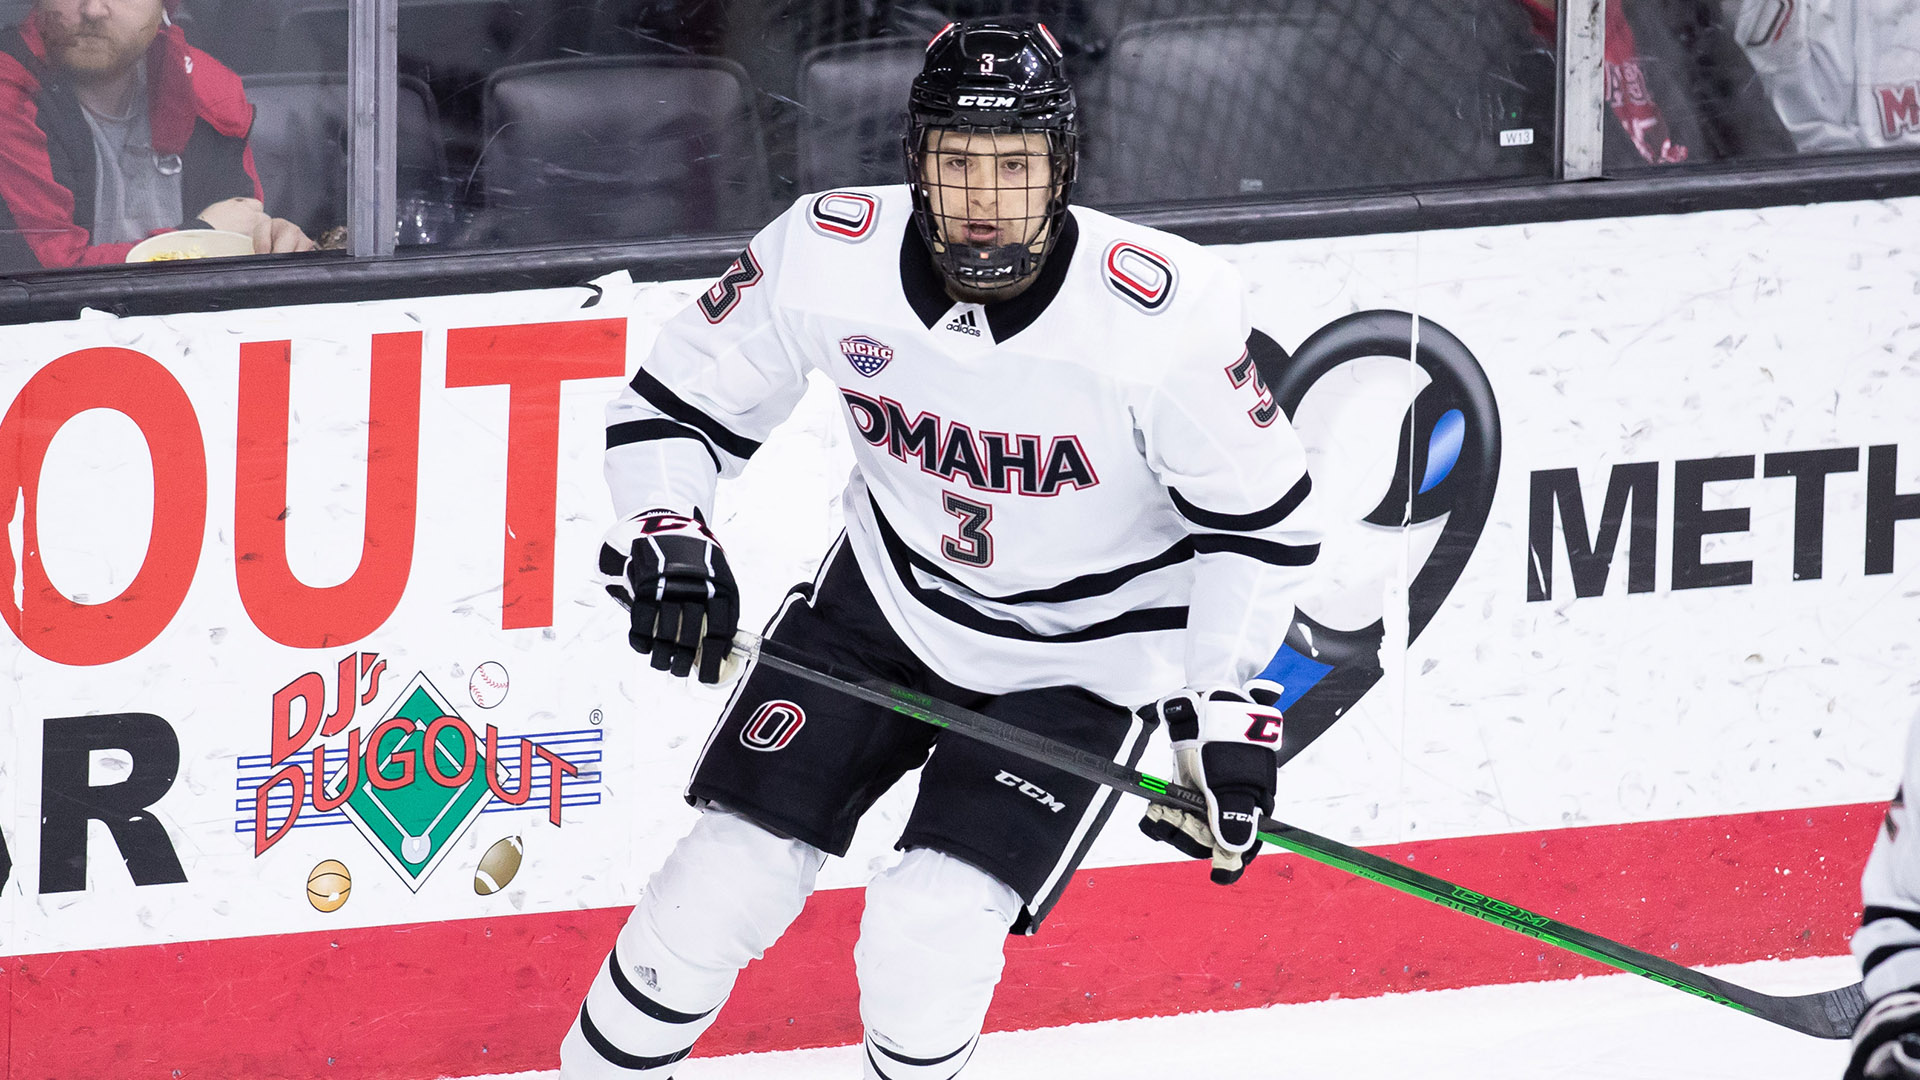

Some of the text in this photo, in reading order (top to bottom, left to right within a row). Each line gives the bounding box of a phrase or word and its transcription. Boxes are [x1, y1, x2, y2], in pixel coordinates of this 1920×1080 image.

[980, 53, 995, 74] 3
[957, 95, 1016, 108] CCM
[1505, 130, 1531, 144] W13
[840, 340, 893, 361] NCHC
[945, 322, 981, 338] adidas
[839, 387, 1100, 497] OMAHA
[0, 317, 627, 666] OUT
[941, 489, 994, 568] 3
[1526, 443, 1920, 603] METH
[893, 705, 950, 728] CCM
[0, 712, 188, 896] R
[255, 715, 578, 858] DUGOUT
[994, 769, 1066, 813] CCM
[1451, 885, 1551, 928] CCM
